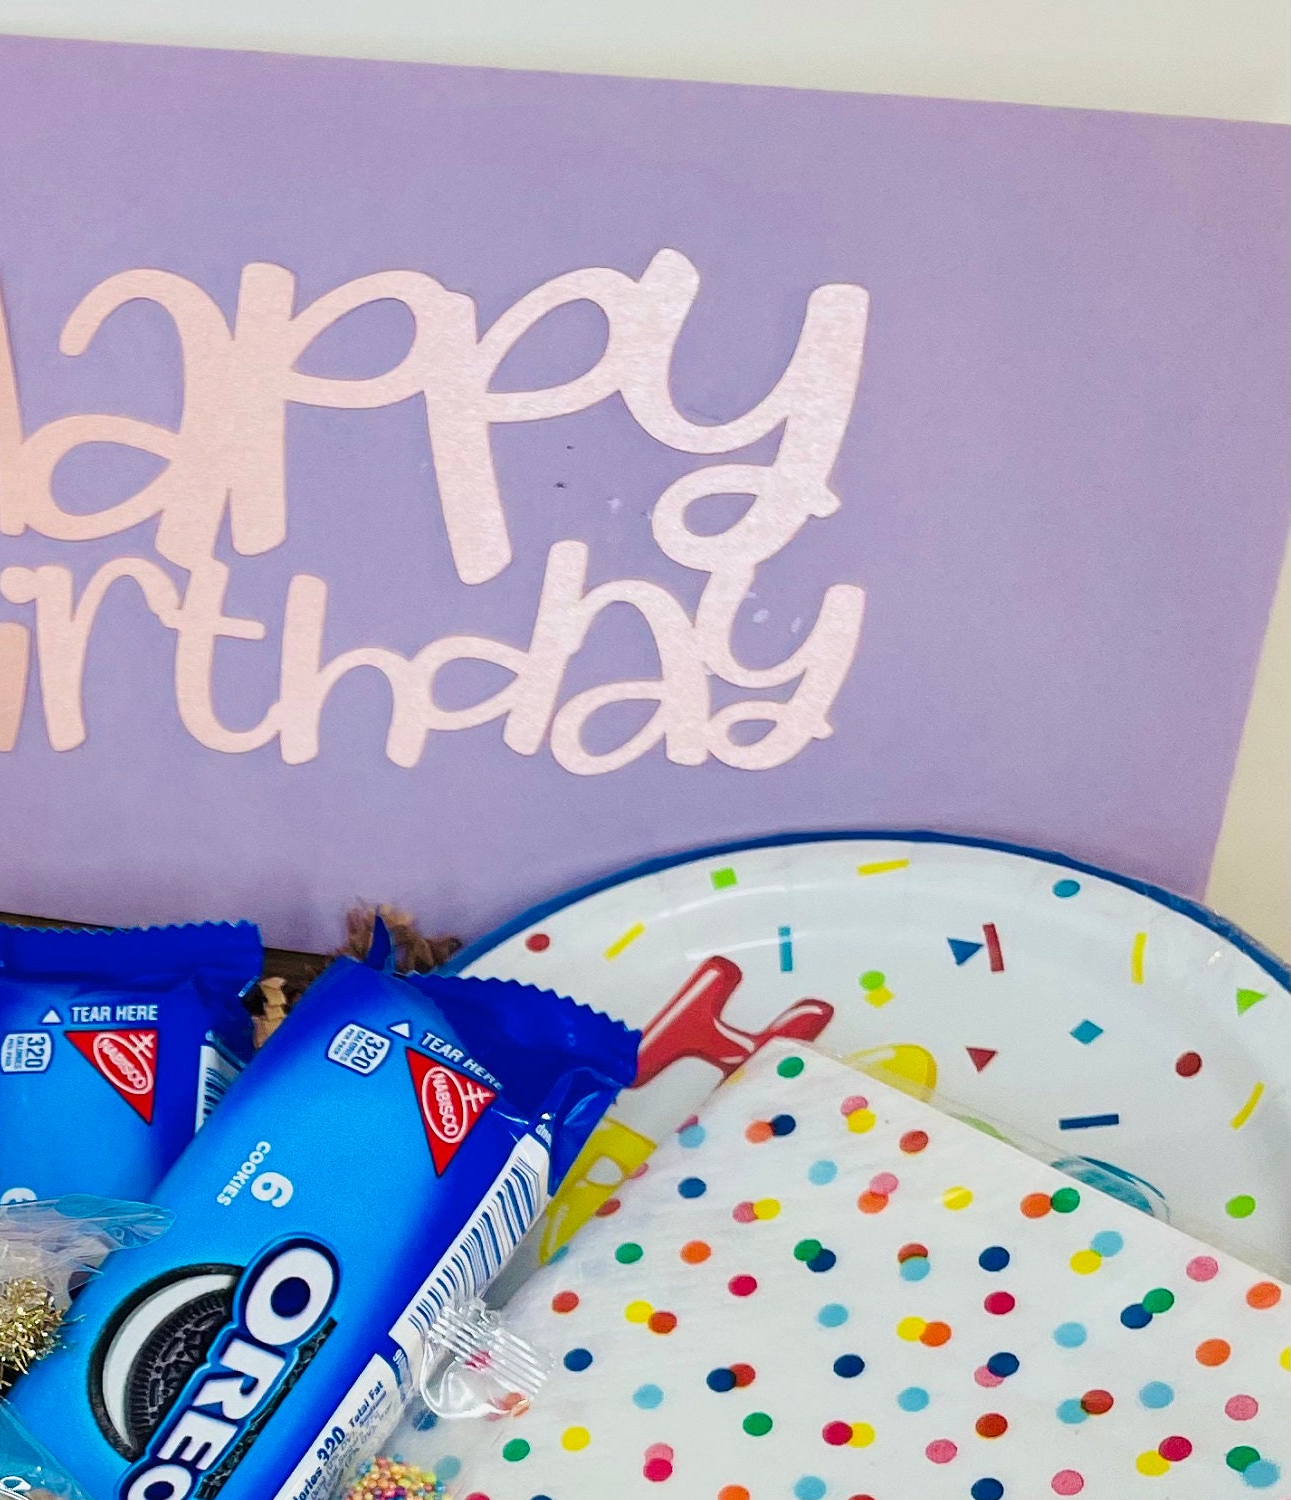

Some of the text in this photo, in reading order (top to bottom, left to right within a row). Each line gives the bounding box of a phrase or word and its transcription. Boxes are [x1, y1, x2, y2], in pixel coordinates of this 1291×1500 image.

[71, 1004, 158, 1023] TEAR HERE
[25, 1036, 46, 1068] 320
[97, 1038, 148, 1090] NABISCO
[351, 1036, 385, 1069] 320
[421, 1031, 464, 1062] TEAR
[430, 1070, 459, 1138] NABISCO
[216, 1140, 272, 1207] COOKIES
[250, 1171, 294, 1208] 6
[316, 1425, 346, 1463] 320
